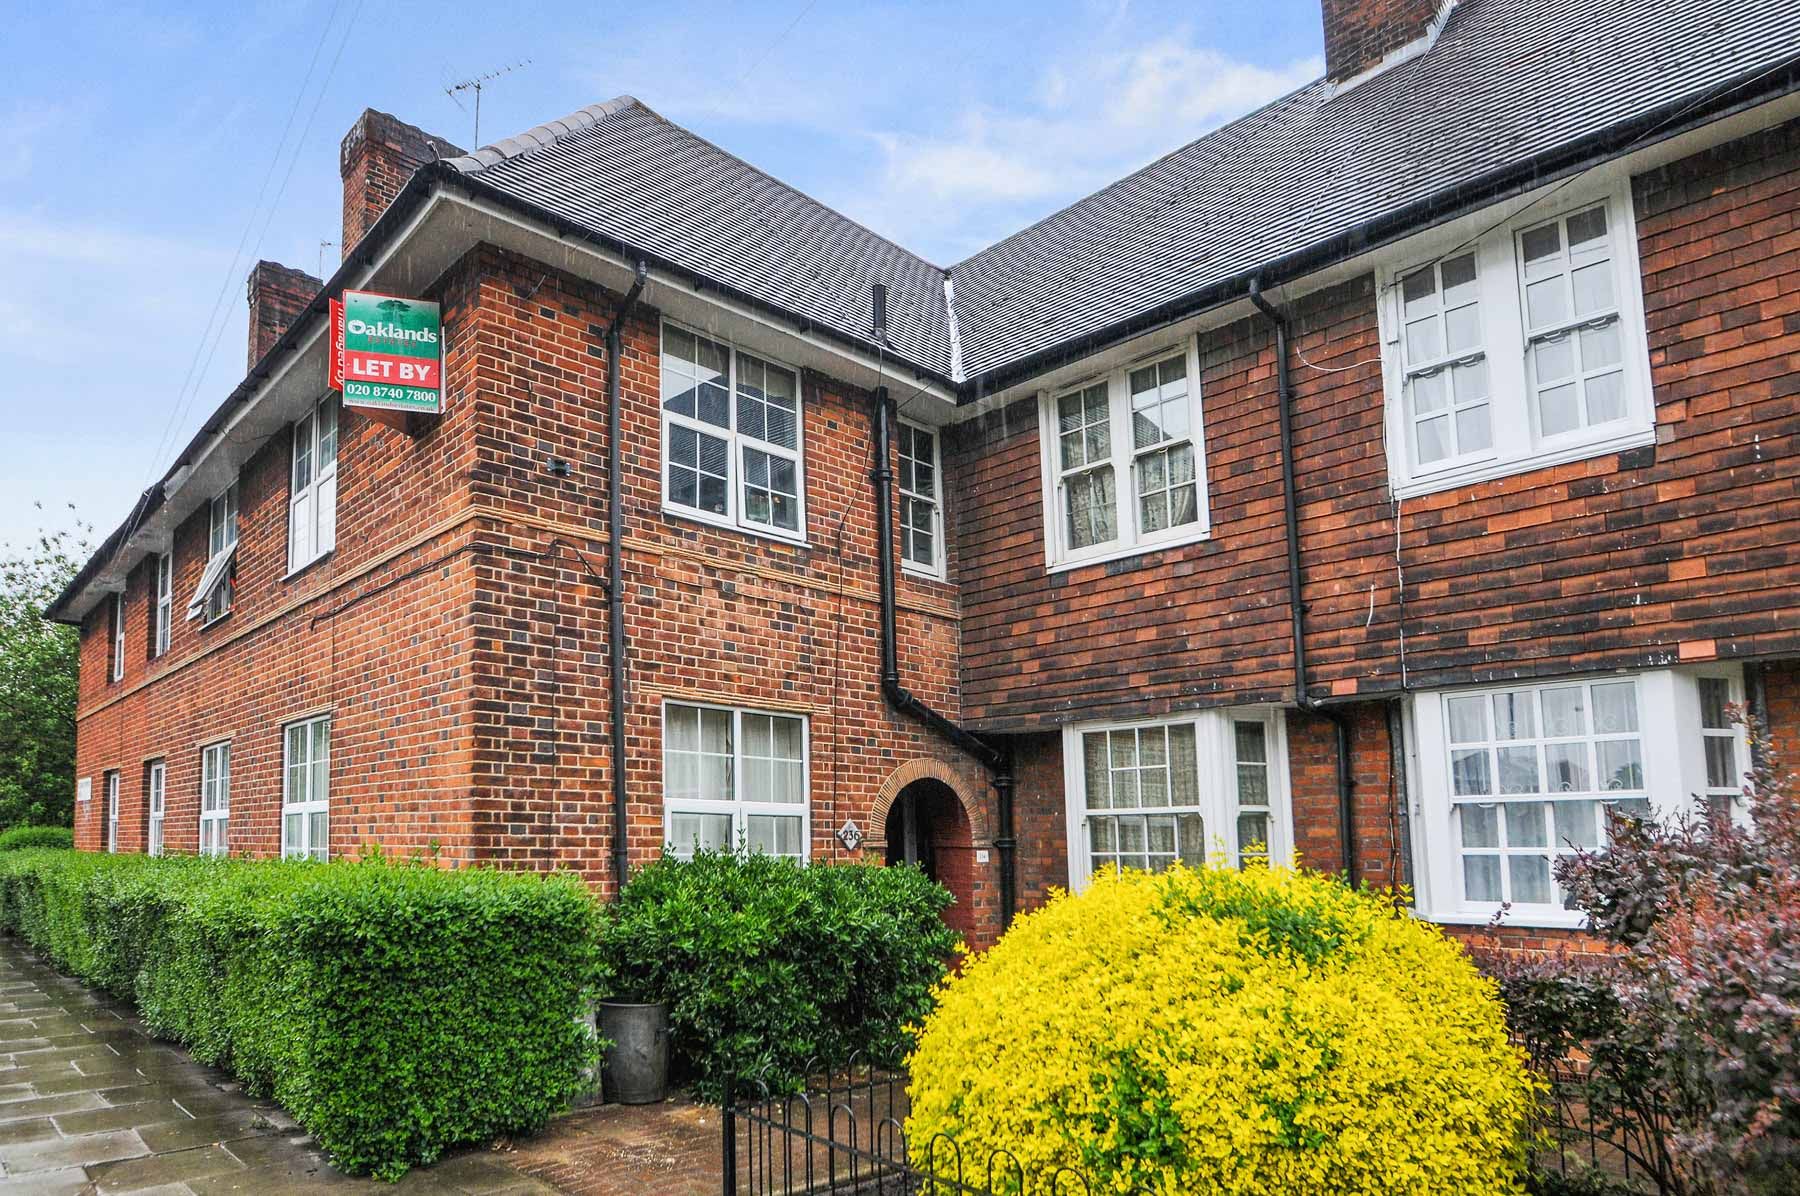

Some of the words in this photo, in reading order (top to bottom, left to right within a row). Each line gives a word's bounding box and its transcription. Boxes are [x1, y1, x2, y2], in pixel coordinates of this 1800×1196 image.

[348, 320, 437, 343] Oaklands
[353, 358, 393, 377] LET
[400, 363, 431, 381] BY
[347, 384, 370, 396] 020
[373, 387, 403, 399] 8740
[407, 390, 436, 402] 7800
[842, 830, 860, 841] 236
